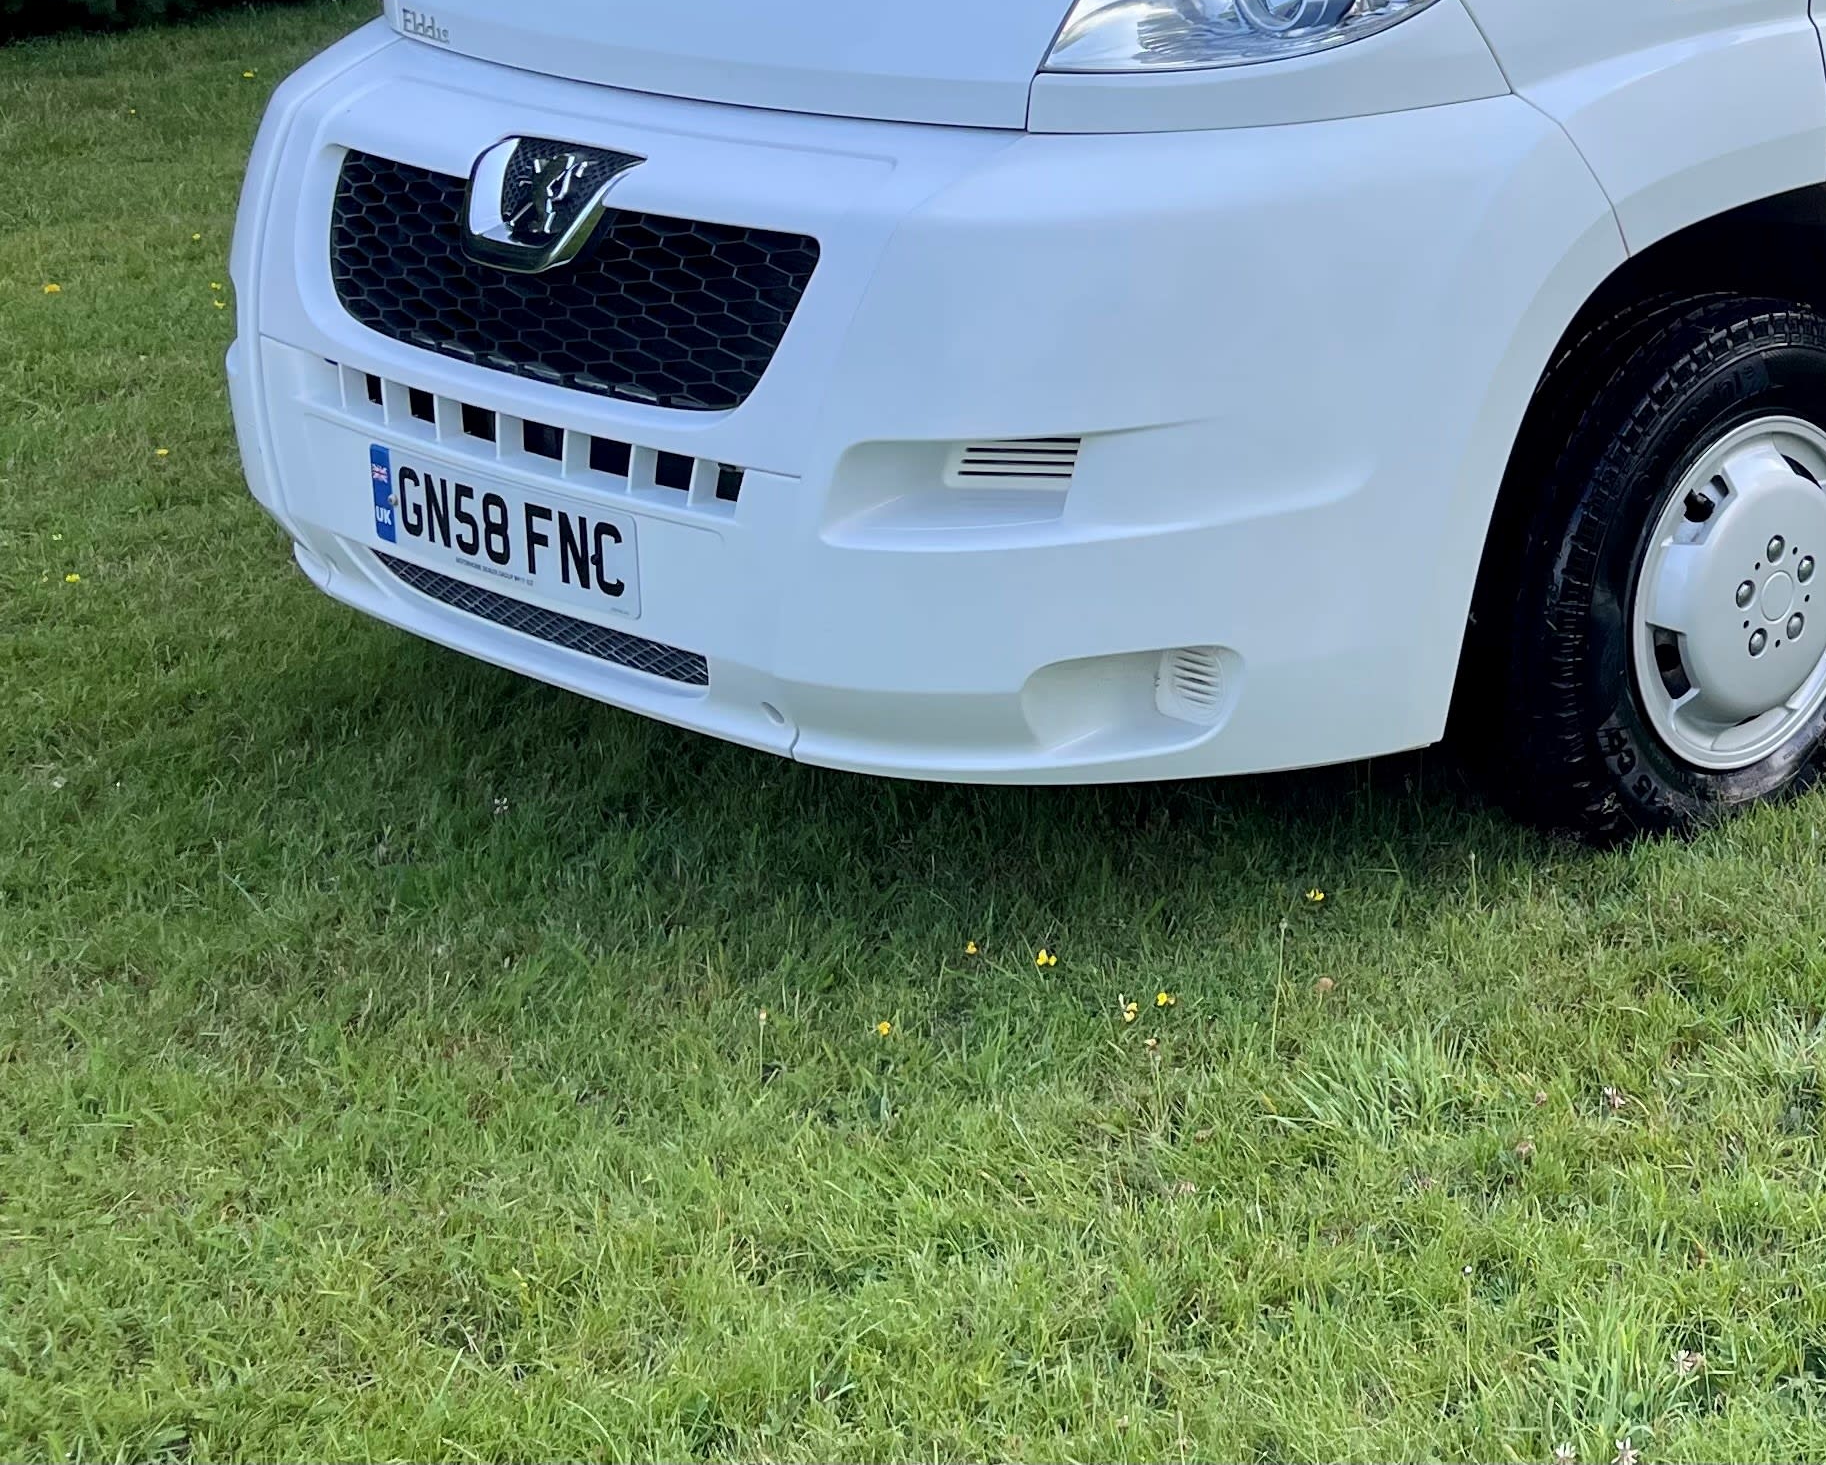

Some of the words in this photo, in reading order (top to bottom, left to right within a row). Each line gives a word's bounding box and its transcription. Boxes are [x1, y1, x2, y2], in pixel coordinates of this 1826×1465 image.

[402, 8, 450, 40] Elddis
[375, 505, 392, 526] UK
[398, 465, 511, 566] GN58
[523, 501, 625, 598] FNC
